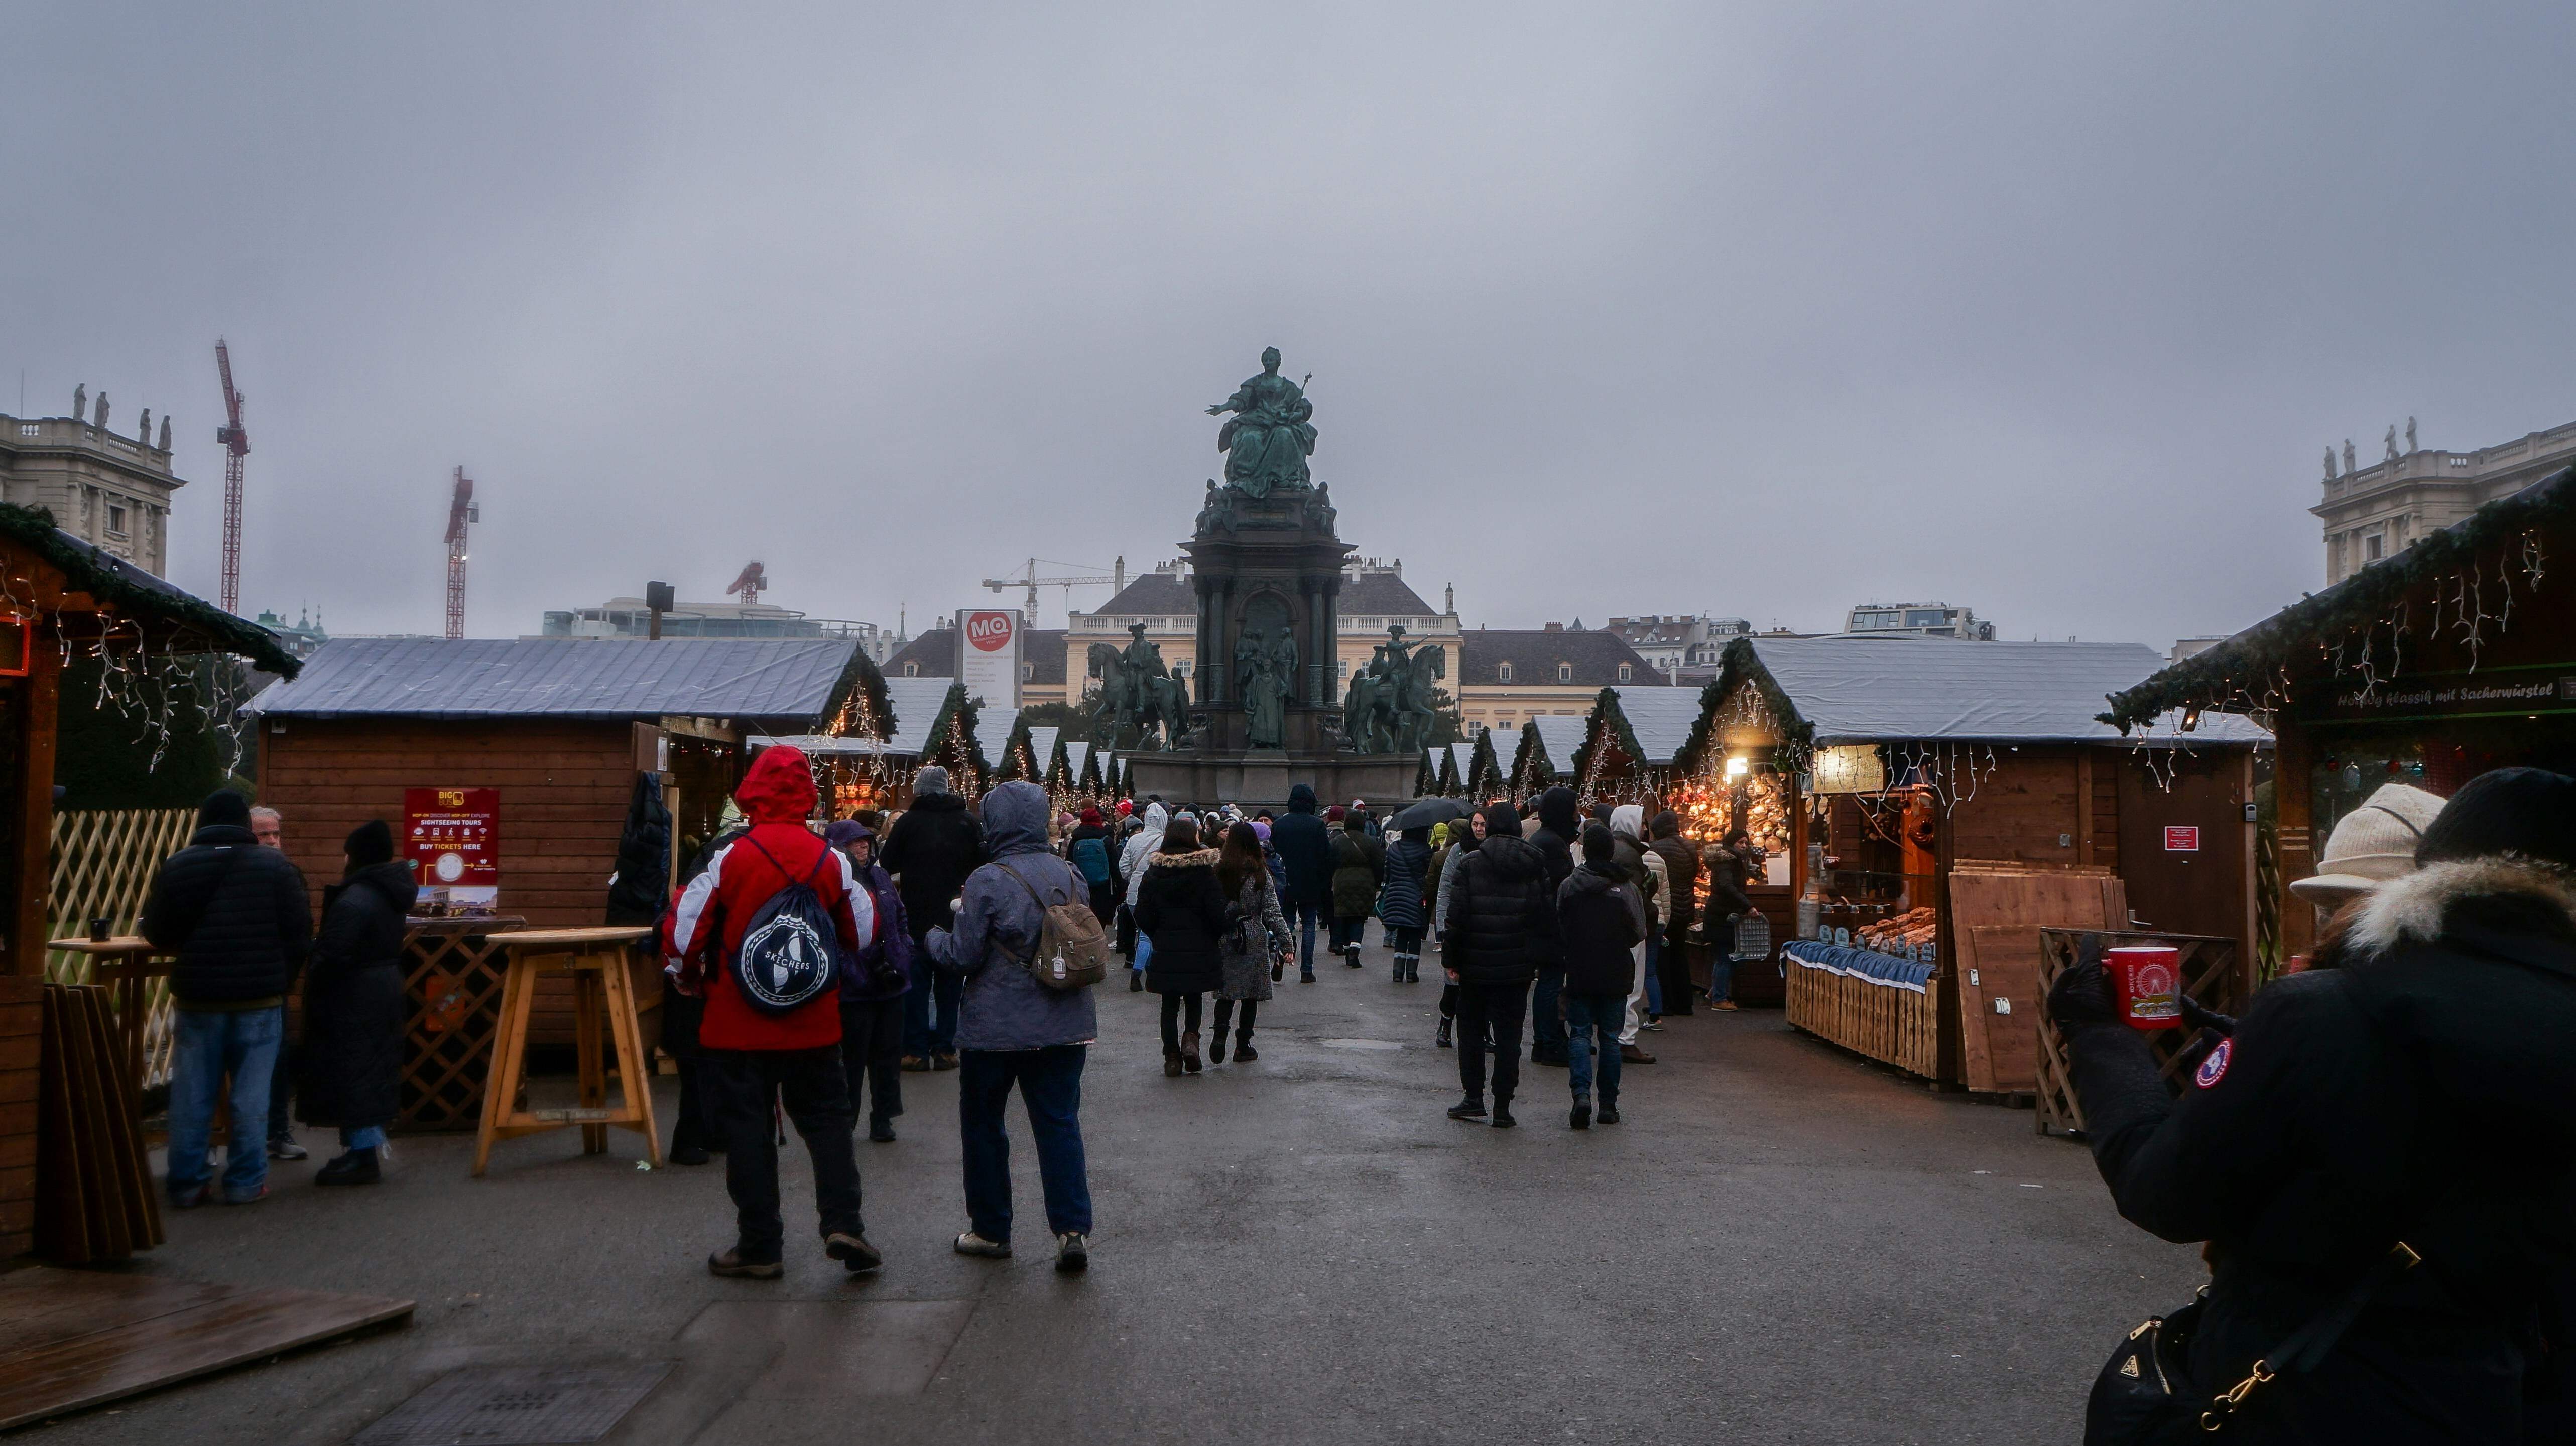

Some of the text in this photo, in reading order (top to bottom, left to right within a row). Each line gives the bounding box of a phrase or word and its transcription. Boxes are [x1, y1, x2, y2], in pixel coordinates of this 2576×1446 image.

[971, 617, 1009, 638] MQ
[2435, 688, 2456, 703] mit
[2460, 682, 2553, 700] Sacherwürstel
[764, 951, 810, 970] SKECHERS
